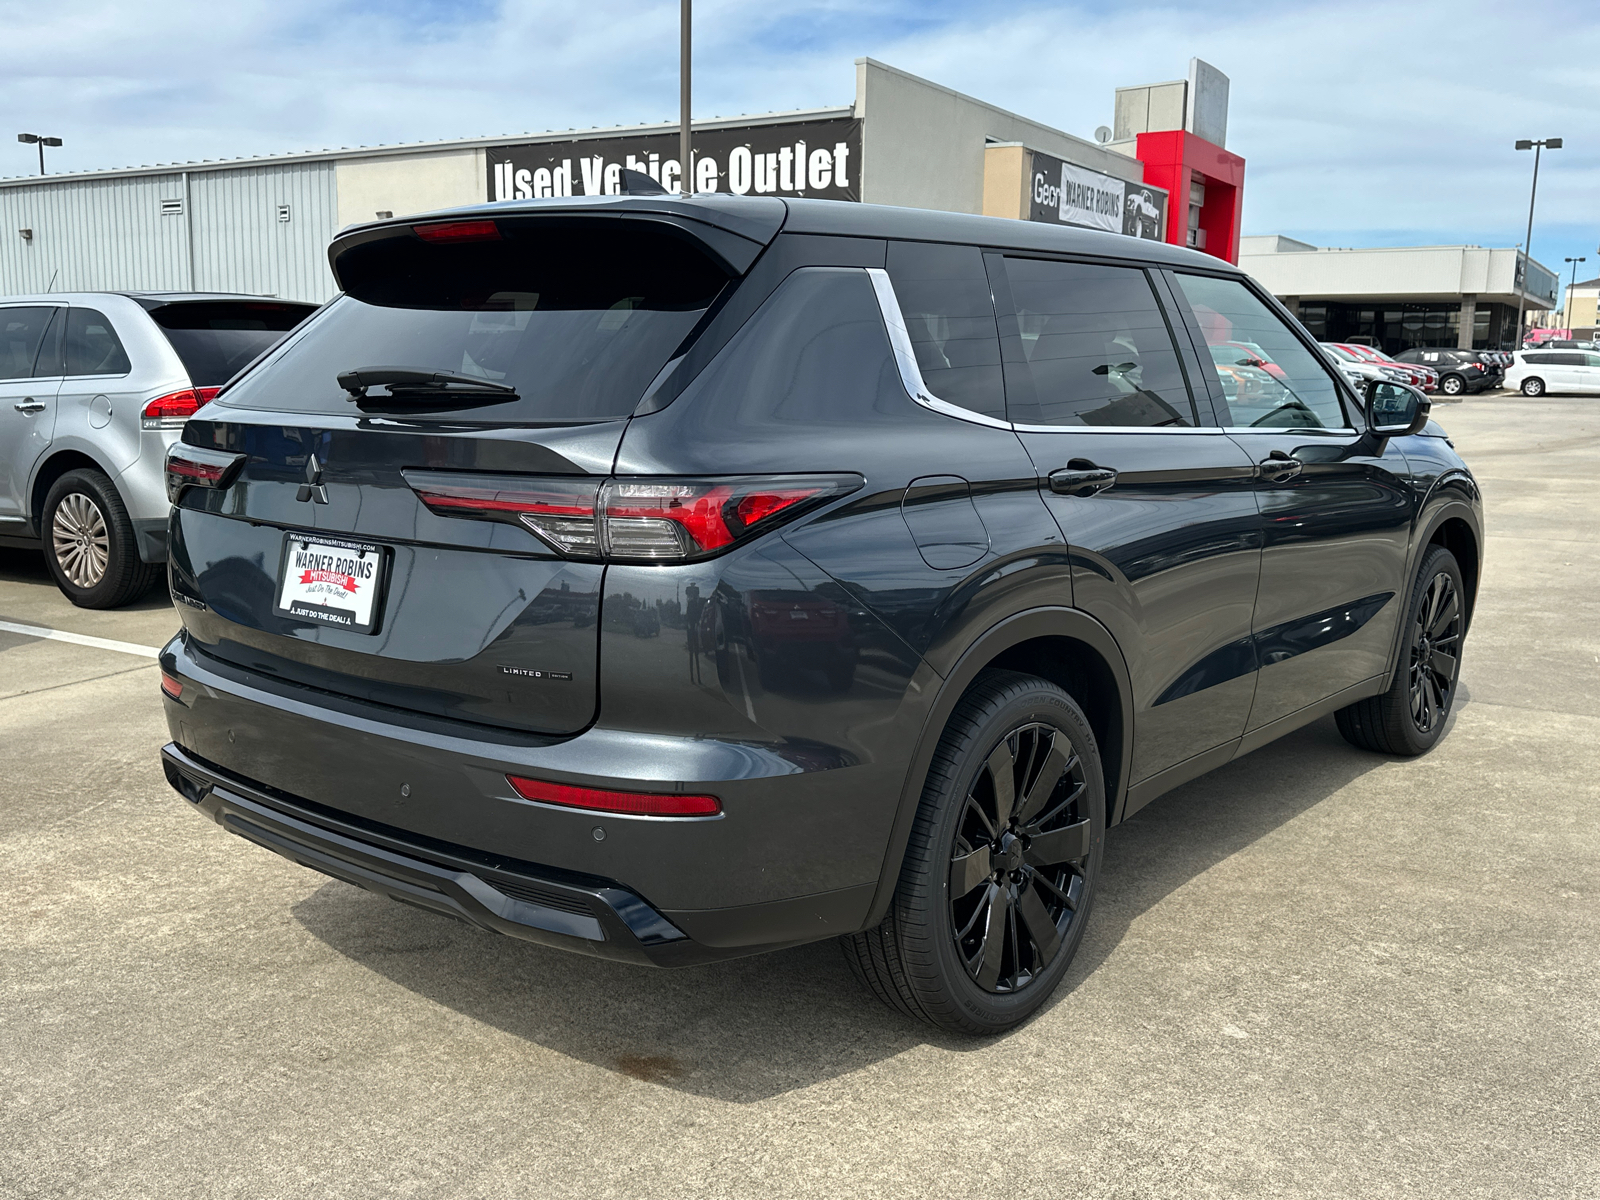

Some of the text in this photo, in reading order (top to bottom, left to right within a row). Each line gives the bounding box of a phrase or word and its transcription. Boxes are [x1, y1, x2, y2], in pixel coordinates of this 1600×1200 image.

[494, 159, 572, 201] Used
[729, 142, 849, 195] Outlet
[1066, 180, 1120, 218] WARNER ROBINS
[295, 551, 373, 579] WARNER ROBINS
[305, 584, 317, 593] Just
[317, 584, 324, 593] Do
[310, 571, 348, 587] MITSUBISHI
[296, 608, 309, 616] JUST
[309, 610, 317, 618] DO
[317, 611, 329, 620] THE
[503, 667, 542, 678] LIMITED
[1048, 698, 1084, 727] COUNTRY
